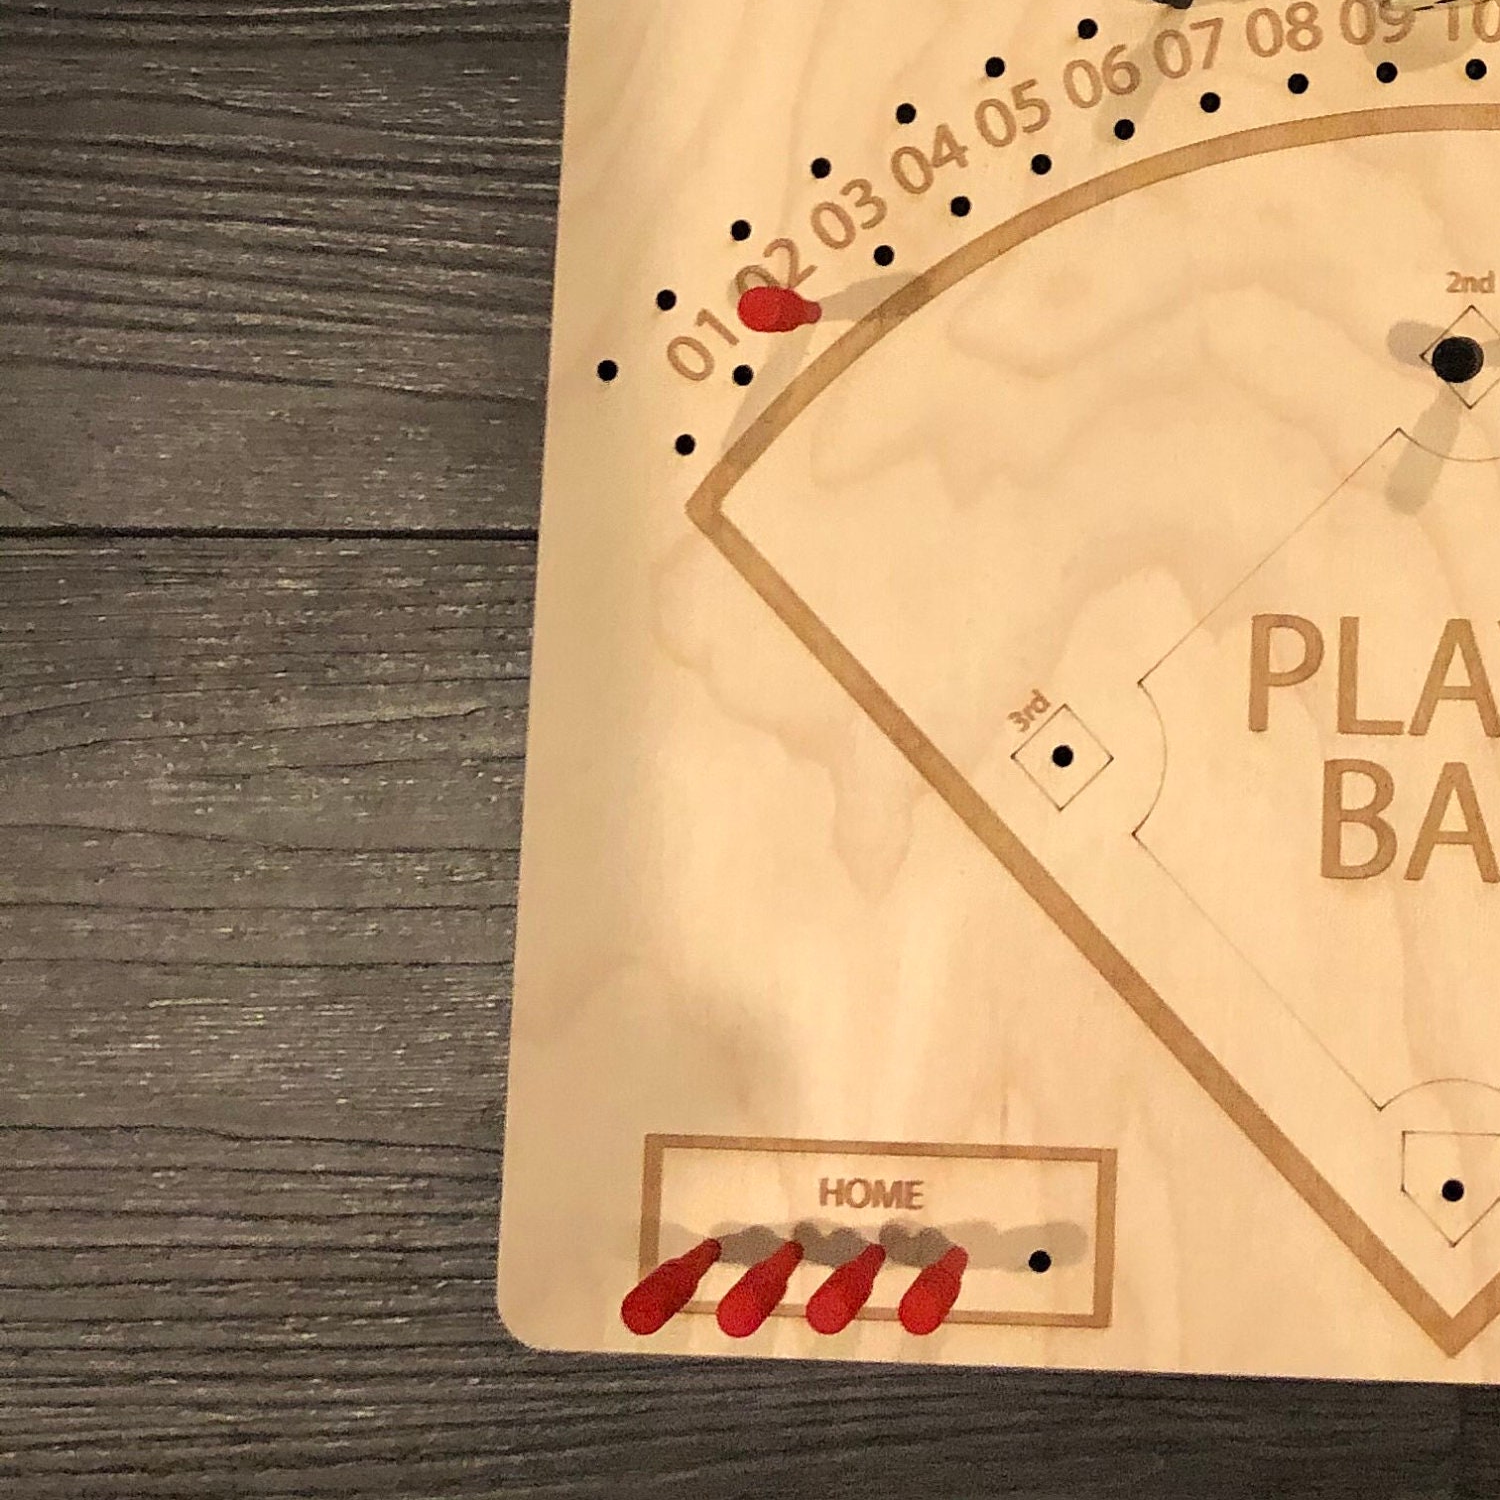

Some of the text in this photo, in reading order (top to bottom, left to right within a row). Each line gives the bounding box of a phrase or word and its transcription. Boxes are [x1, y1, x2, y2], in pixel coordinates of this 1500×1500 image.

[667, 308, 740, 381] 01
[812, 178, 888, 248] 03
[892, 124, 968, 194] 04
[975, 79, 1051, 146] 05
[1063, 44, 1141, 109] 06
[1153, 18, 1224, 79] 07
[1245, 1, 1324, 57] 08
[1446, 271, 1495, 295] 2nd
[1007, 689, 1050, 732] 3rd
[819, 1177, 924, 1209] HOME
